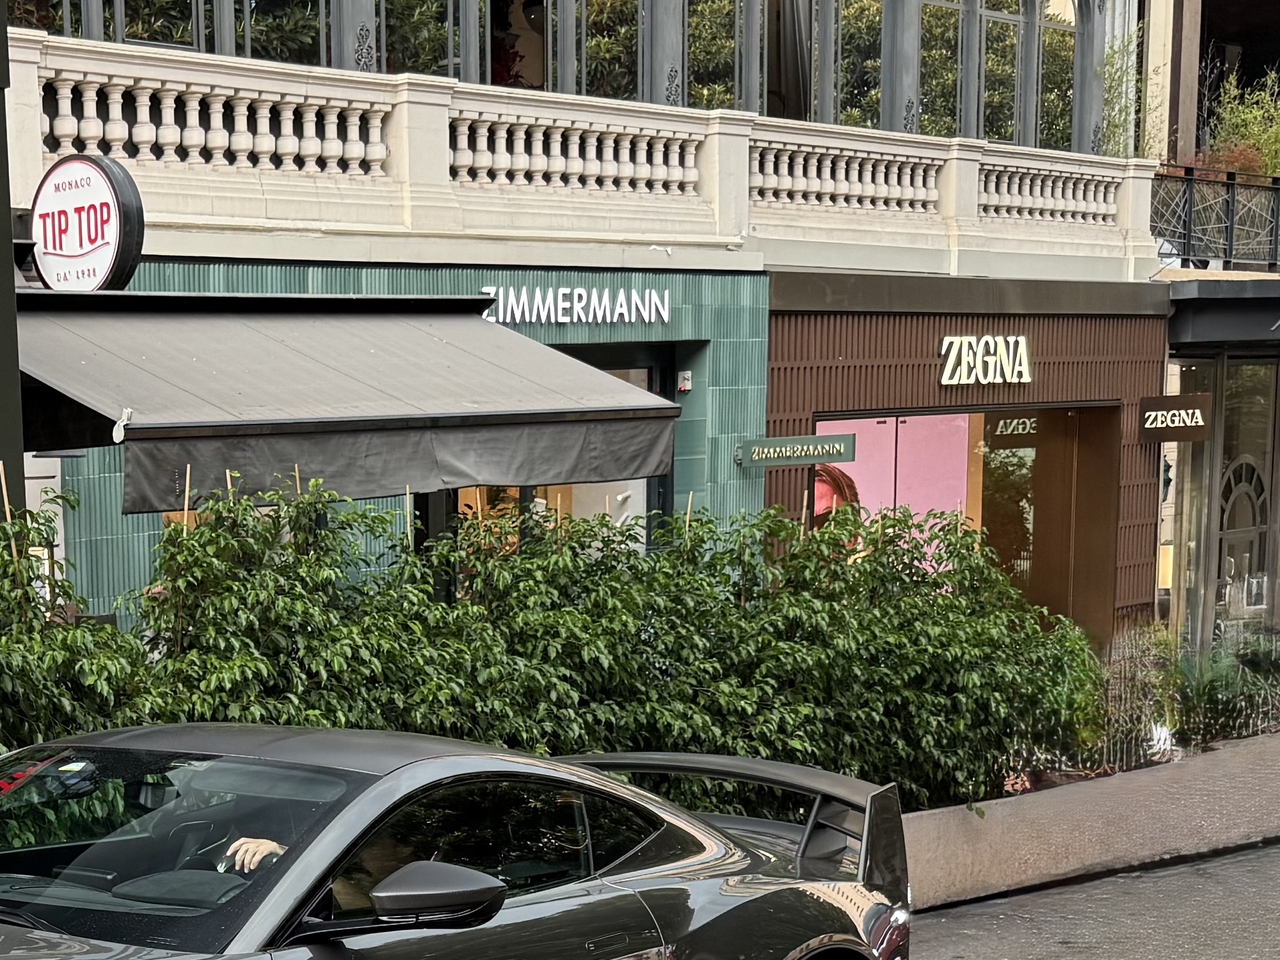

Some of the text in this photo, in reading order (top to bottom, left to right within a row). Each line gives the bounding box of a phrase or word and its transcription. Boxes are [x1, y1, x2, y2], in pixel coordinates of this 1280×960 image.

[53, 177, 92, 193] MONACO
[39, 202, 111, 251] TIP TOP
[481, 286, 669, 324] ZIMMERMANN
[941, 335, 1032, 385] ZEGNA
[1144, 408, 1205, 428] ZEGNA
[751, 442, 844, 461] ZIMMERMANN
